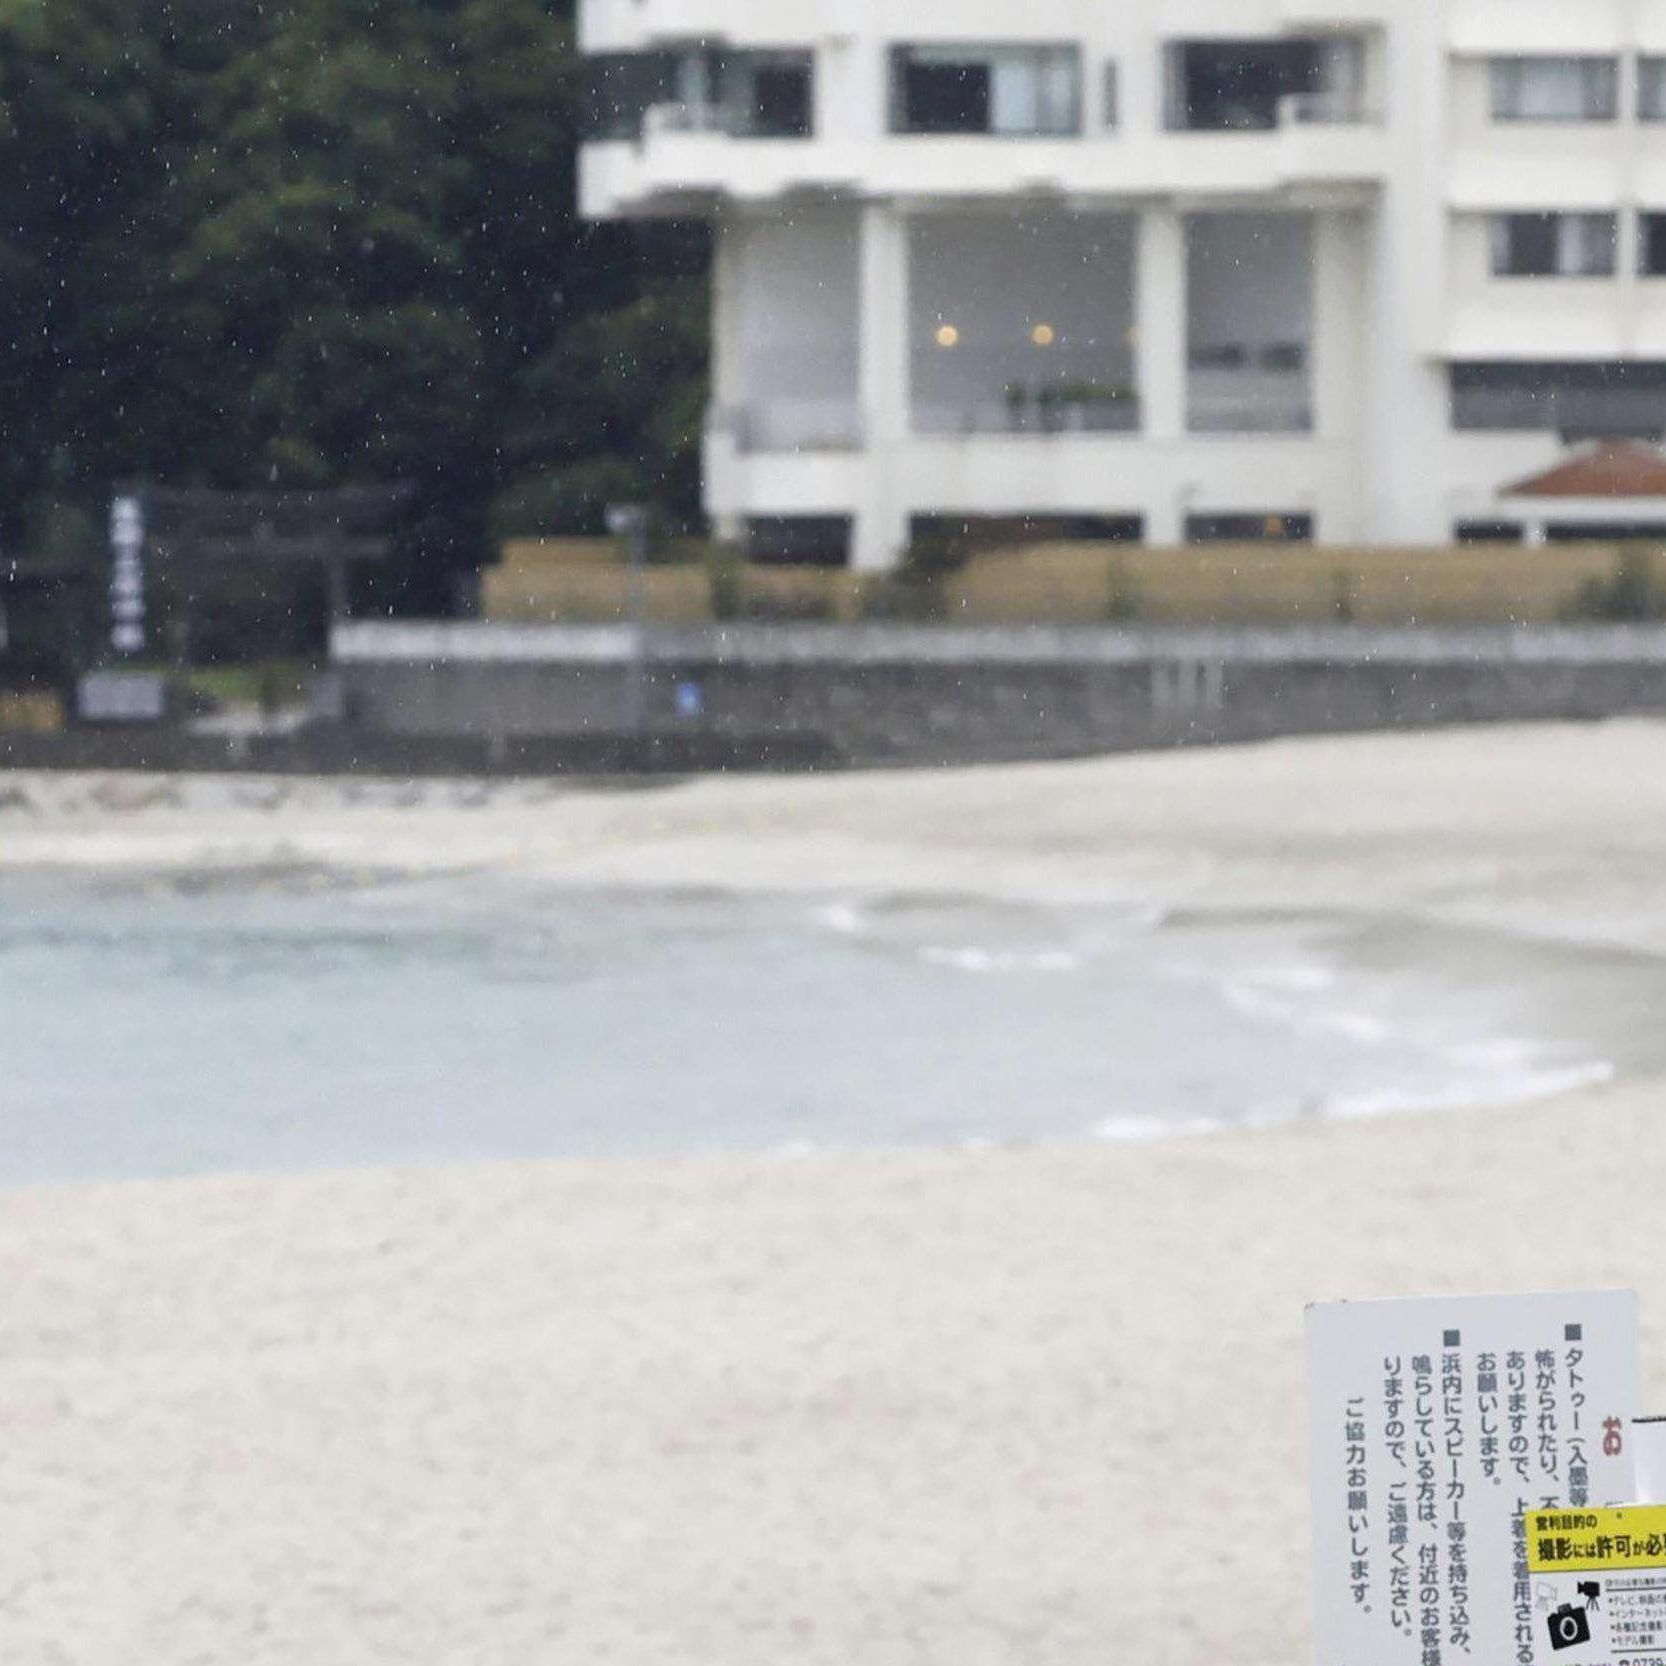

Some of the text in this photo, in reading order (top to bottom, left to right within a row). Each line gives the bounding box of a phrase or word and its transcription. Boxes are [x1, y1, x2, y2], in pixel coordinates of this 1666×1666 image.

[1345, 1398, 1371, 1612] ご協力お願いします。
[1384, 1357, 1413, 1636] りますので、ご遠慮ください。
[1477, 1353, 1500, 1484] お願いします。
